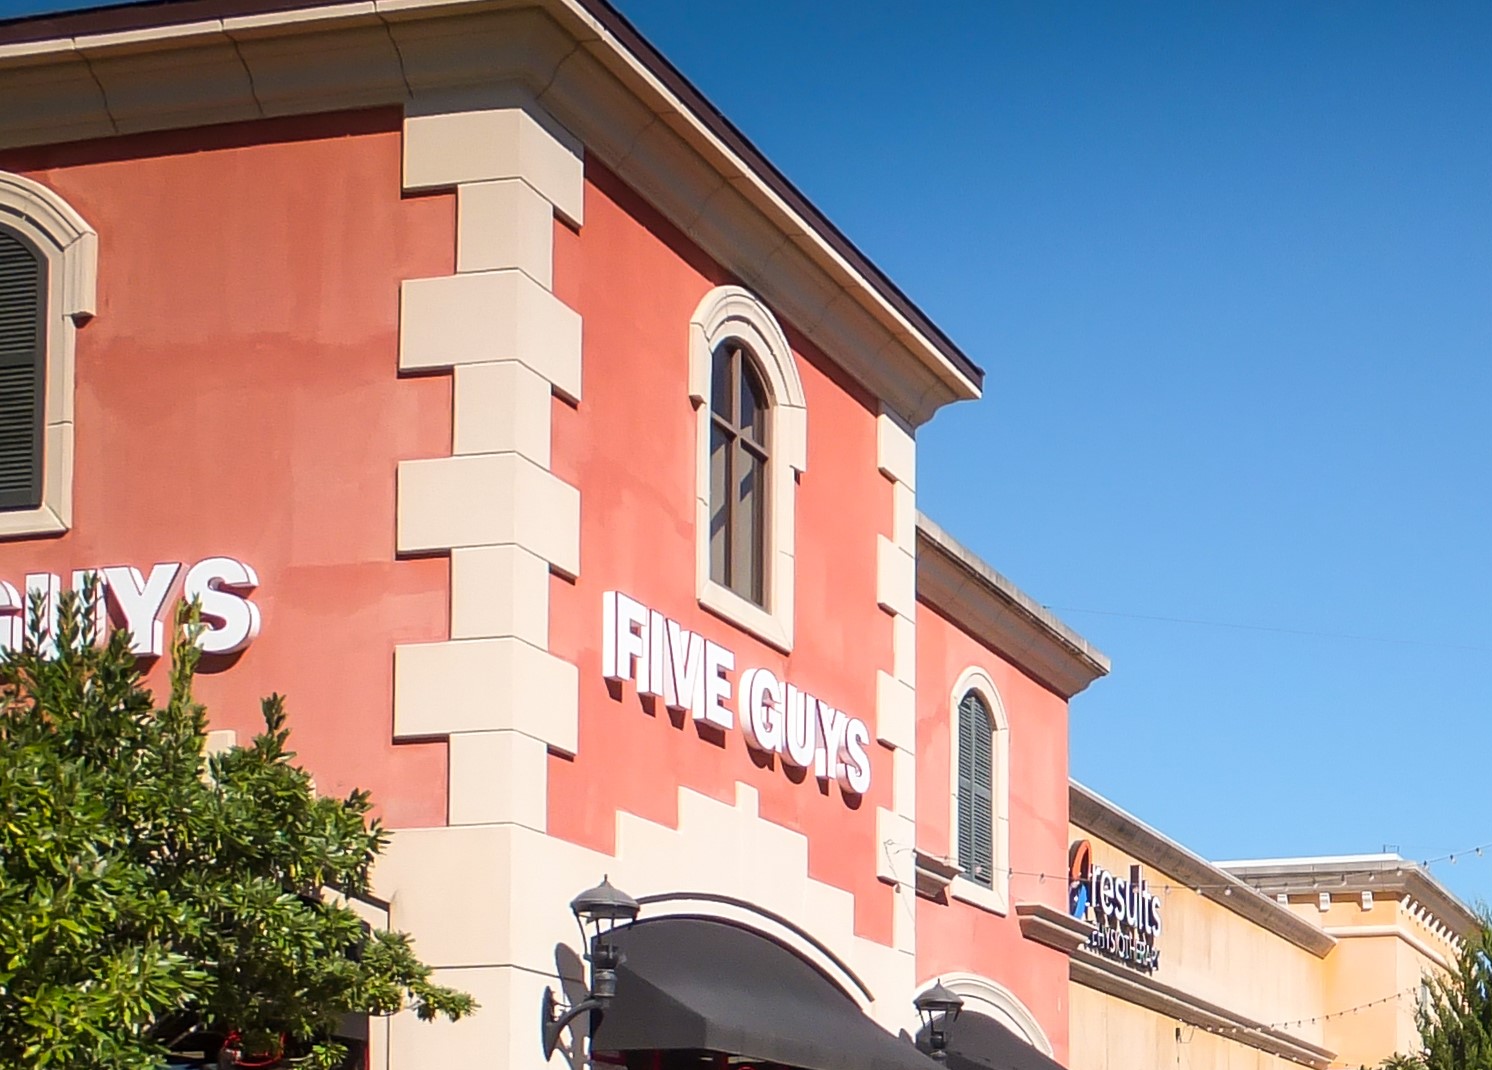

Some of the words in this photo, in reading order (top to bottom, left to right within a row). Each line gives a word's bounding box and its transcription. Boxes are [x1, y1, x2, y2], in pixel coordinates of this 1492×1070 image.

[0, 556, 260, 661] UYS
[603, 591, 734, 730] FIVE
[738, 668, 871, 794] GUYS
[1092, 864, 1161, 937] results
